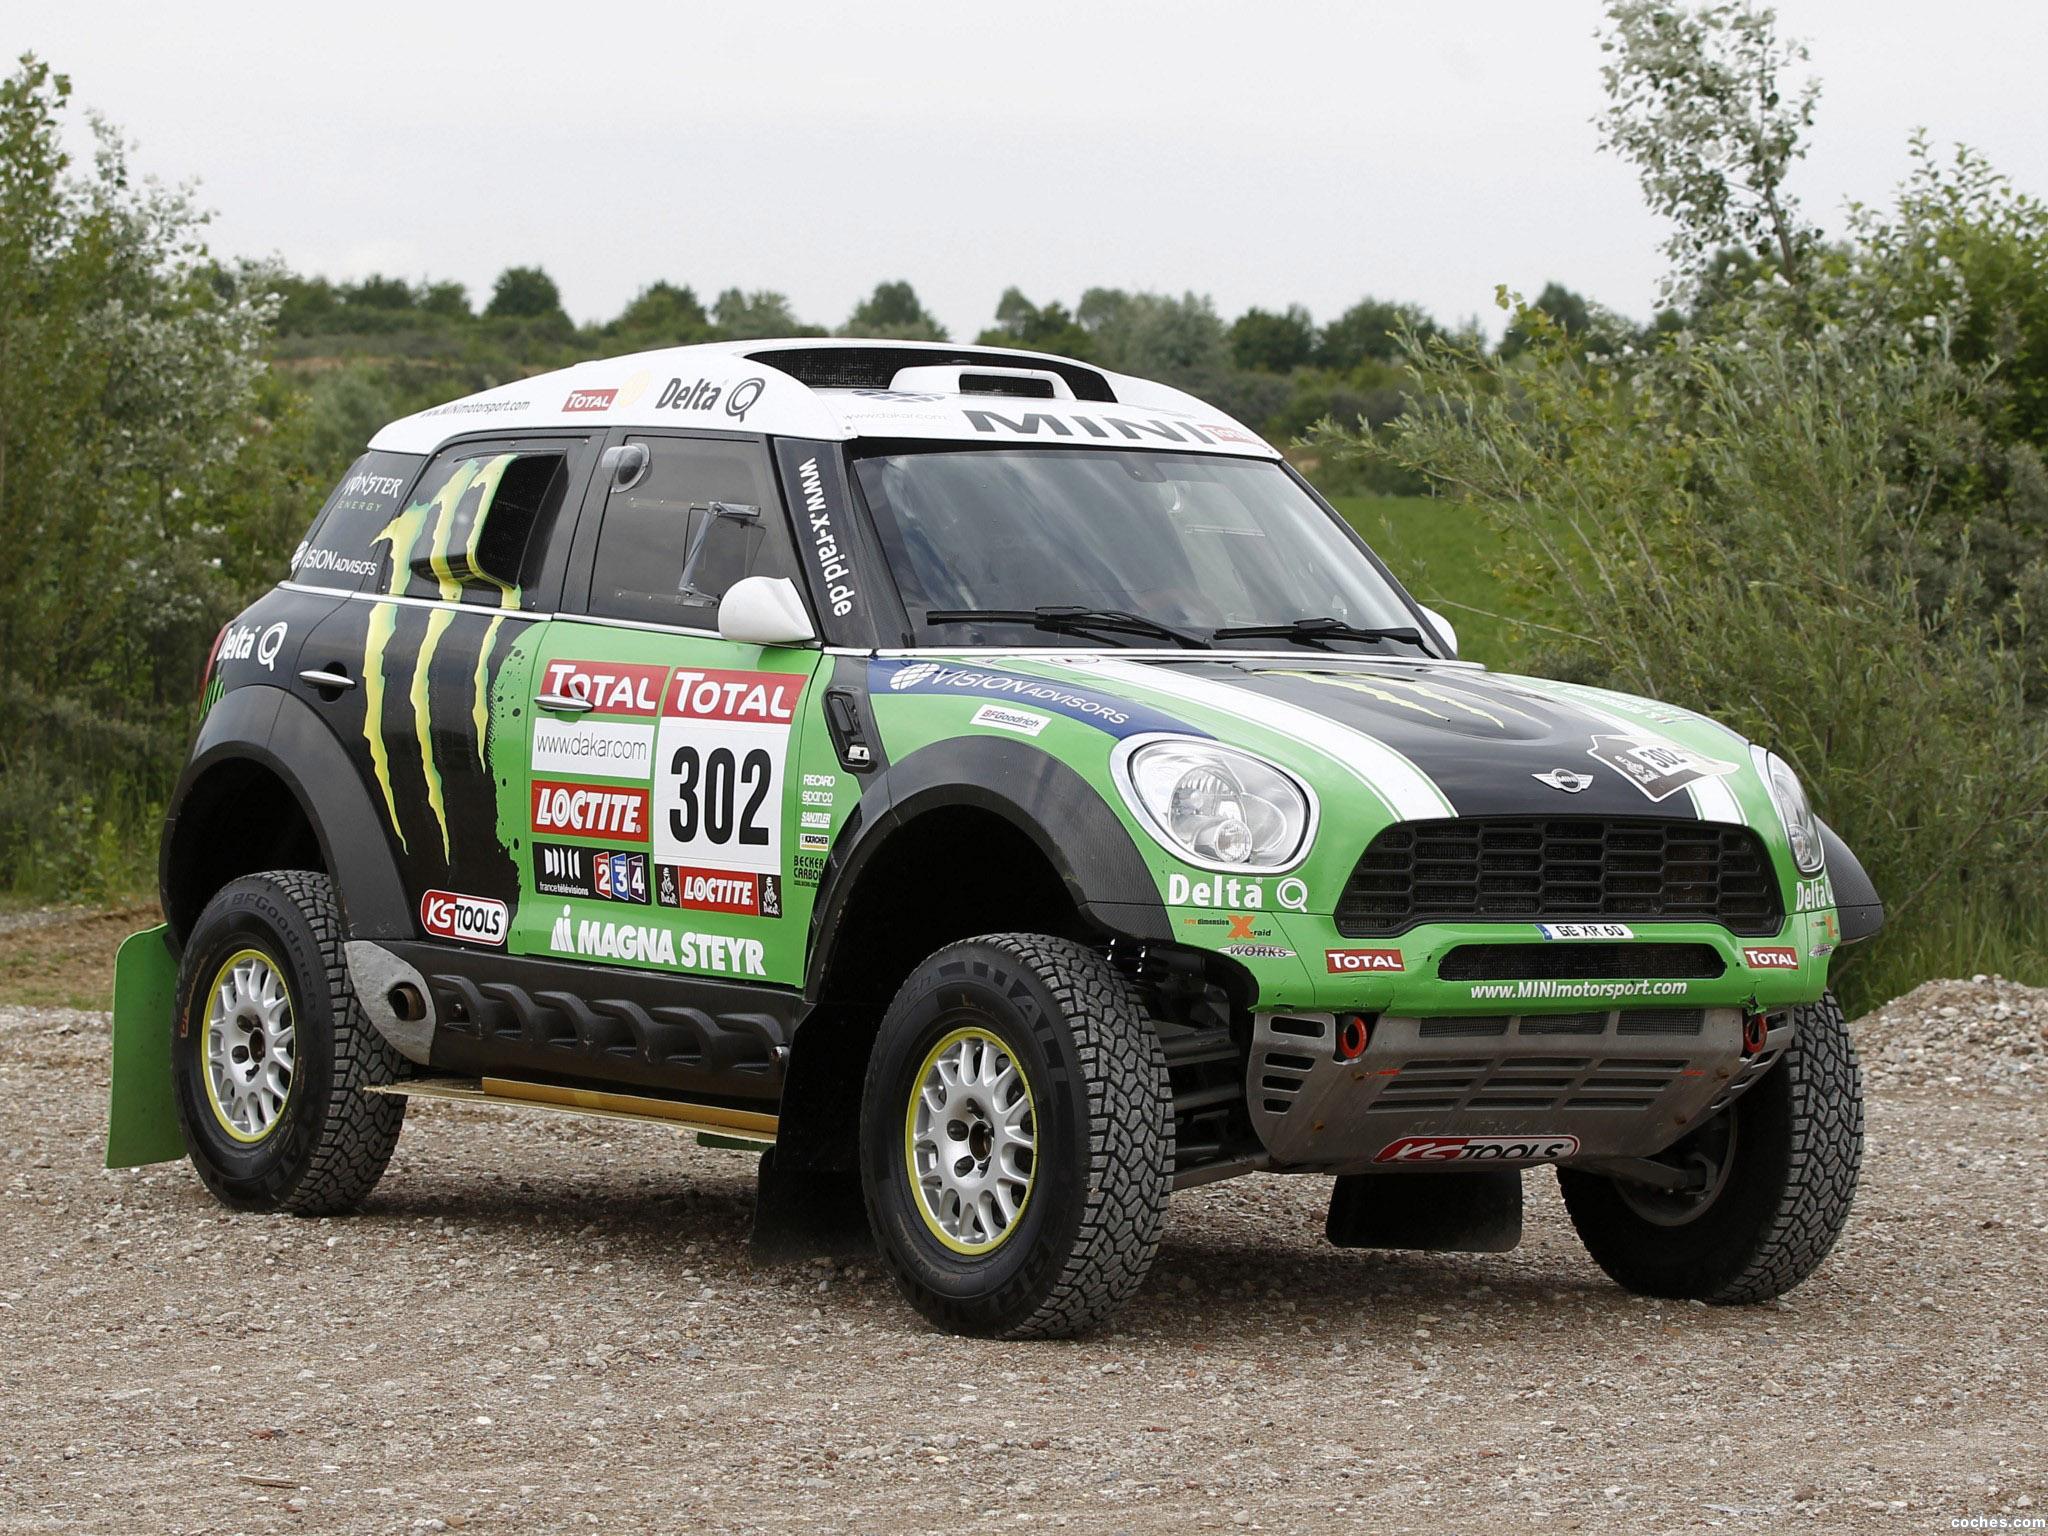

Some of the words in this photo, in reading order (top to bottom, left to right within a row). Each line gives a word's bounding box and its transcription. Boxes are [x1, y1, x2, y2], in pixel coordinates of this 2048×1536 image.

[567, 392, 610, 408] TOTAL
[655, 377, 722, 411] Delta
[725, 377, 766, 423] Q
[961, 409, 1218, 445] MINI
[343, 472, 404, 498] MONSTER
[337, 500, 383, 512] ENERGY
[798, 457, 856, 617] www.x-raid.de
[215, 625, 256, 661] Delta
[674, 671, 793, 719] TOTAL
[981, 709, 1041, 728] BFGoodrich
[536, 732, 648, 761] www.dakar.com
[1639, 747, 1688, 769] 302
[803, 774, 836, 787] RECARO
[1556, 774, 1579, 784] MINI
[668, 745, 773, 847] 302
[801, 790, 834, 806] sparco
[535, 787, 642, 834] LOCTITE
[793, 855, 825, 868] BECKER
[597, 863, 611, 891] 2
[614, 865, 629, 893] 3
[631, 866, 646, 895] 4
[683, 876, 754, 906] LOCTITE
[1168, 873, 1263, 909] Delta
[1276, 877, 1309, 913] Q
[1795, 880, 1827, 912] Delta
[426, 897, 456, 929] KS
[454, 903, 502, 936] TOOLS
[1197, 918, 1230, 926] dimension
[1555, 924, 1580, 937] GE
[1580, 924, 1602, 937] XR
[1605, 924, 1625, 937] 60
[577, 920, 678, 967] MAGNA
[680, 931, 767, 977] STEYR
[1230, 945, 1287, 958] WORKS
[1744, 950, 1798, 966] TOTAL
[1328, 953, 1403, 970] TOTAL
[1470, 979, 1688, 1000] www.MINImotorsport.com
[1459, 1143, 1565, 1161] TOOLS
